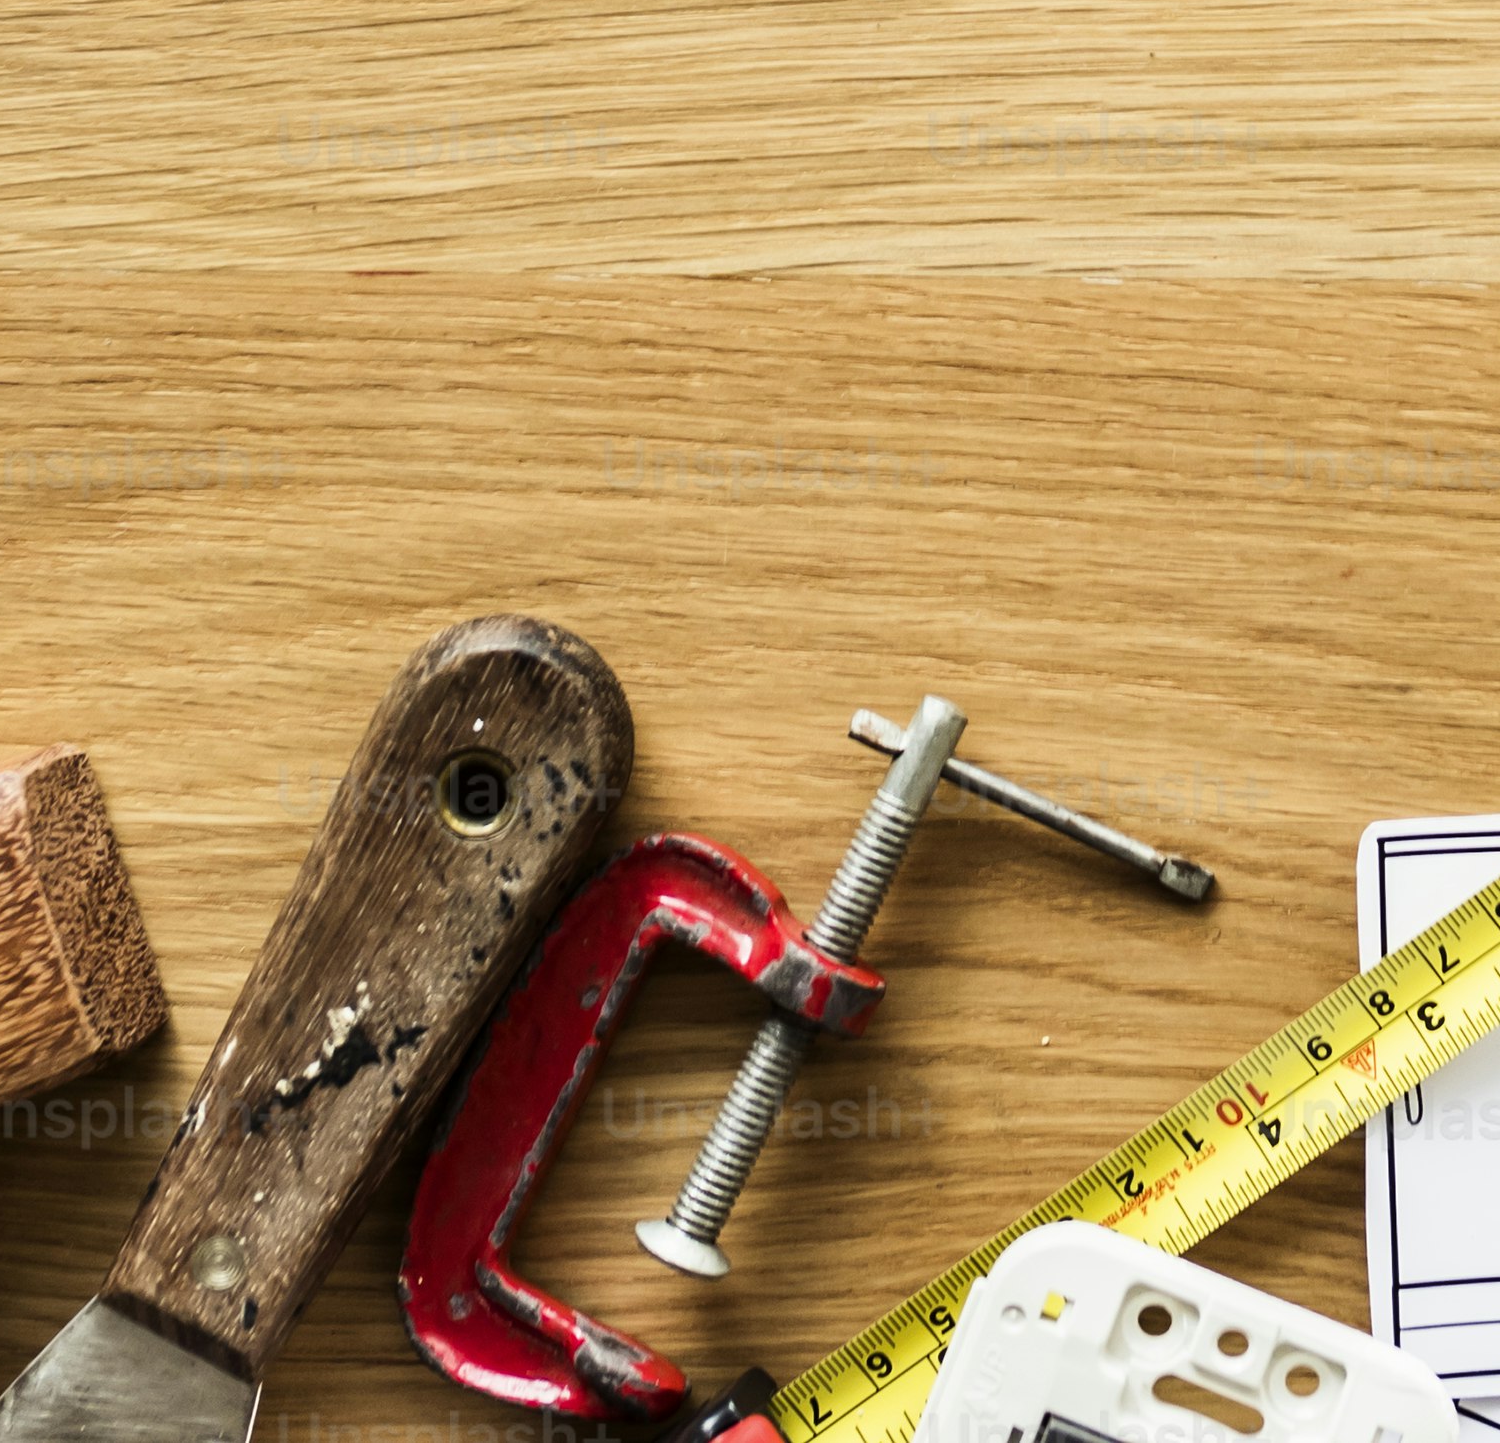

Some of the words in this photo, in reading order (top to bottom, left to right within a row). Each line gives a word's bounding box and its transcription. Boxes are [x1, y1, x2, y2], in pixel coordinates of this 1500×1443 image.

[1436, 945, 1461, 974] 7
[1369, 989, 1395, 1017] 8
[1417, 1001, 1446, 1031] 3
[1215, 1082, 1269, 1127] 10
[1258, 1117, 1282, 1148] 4
